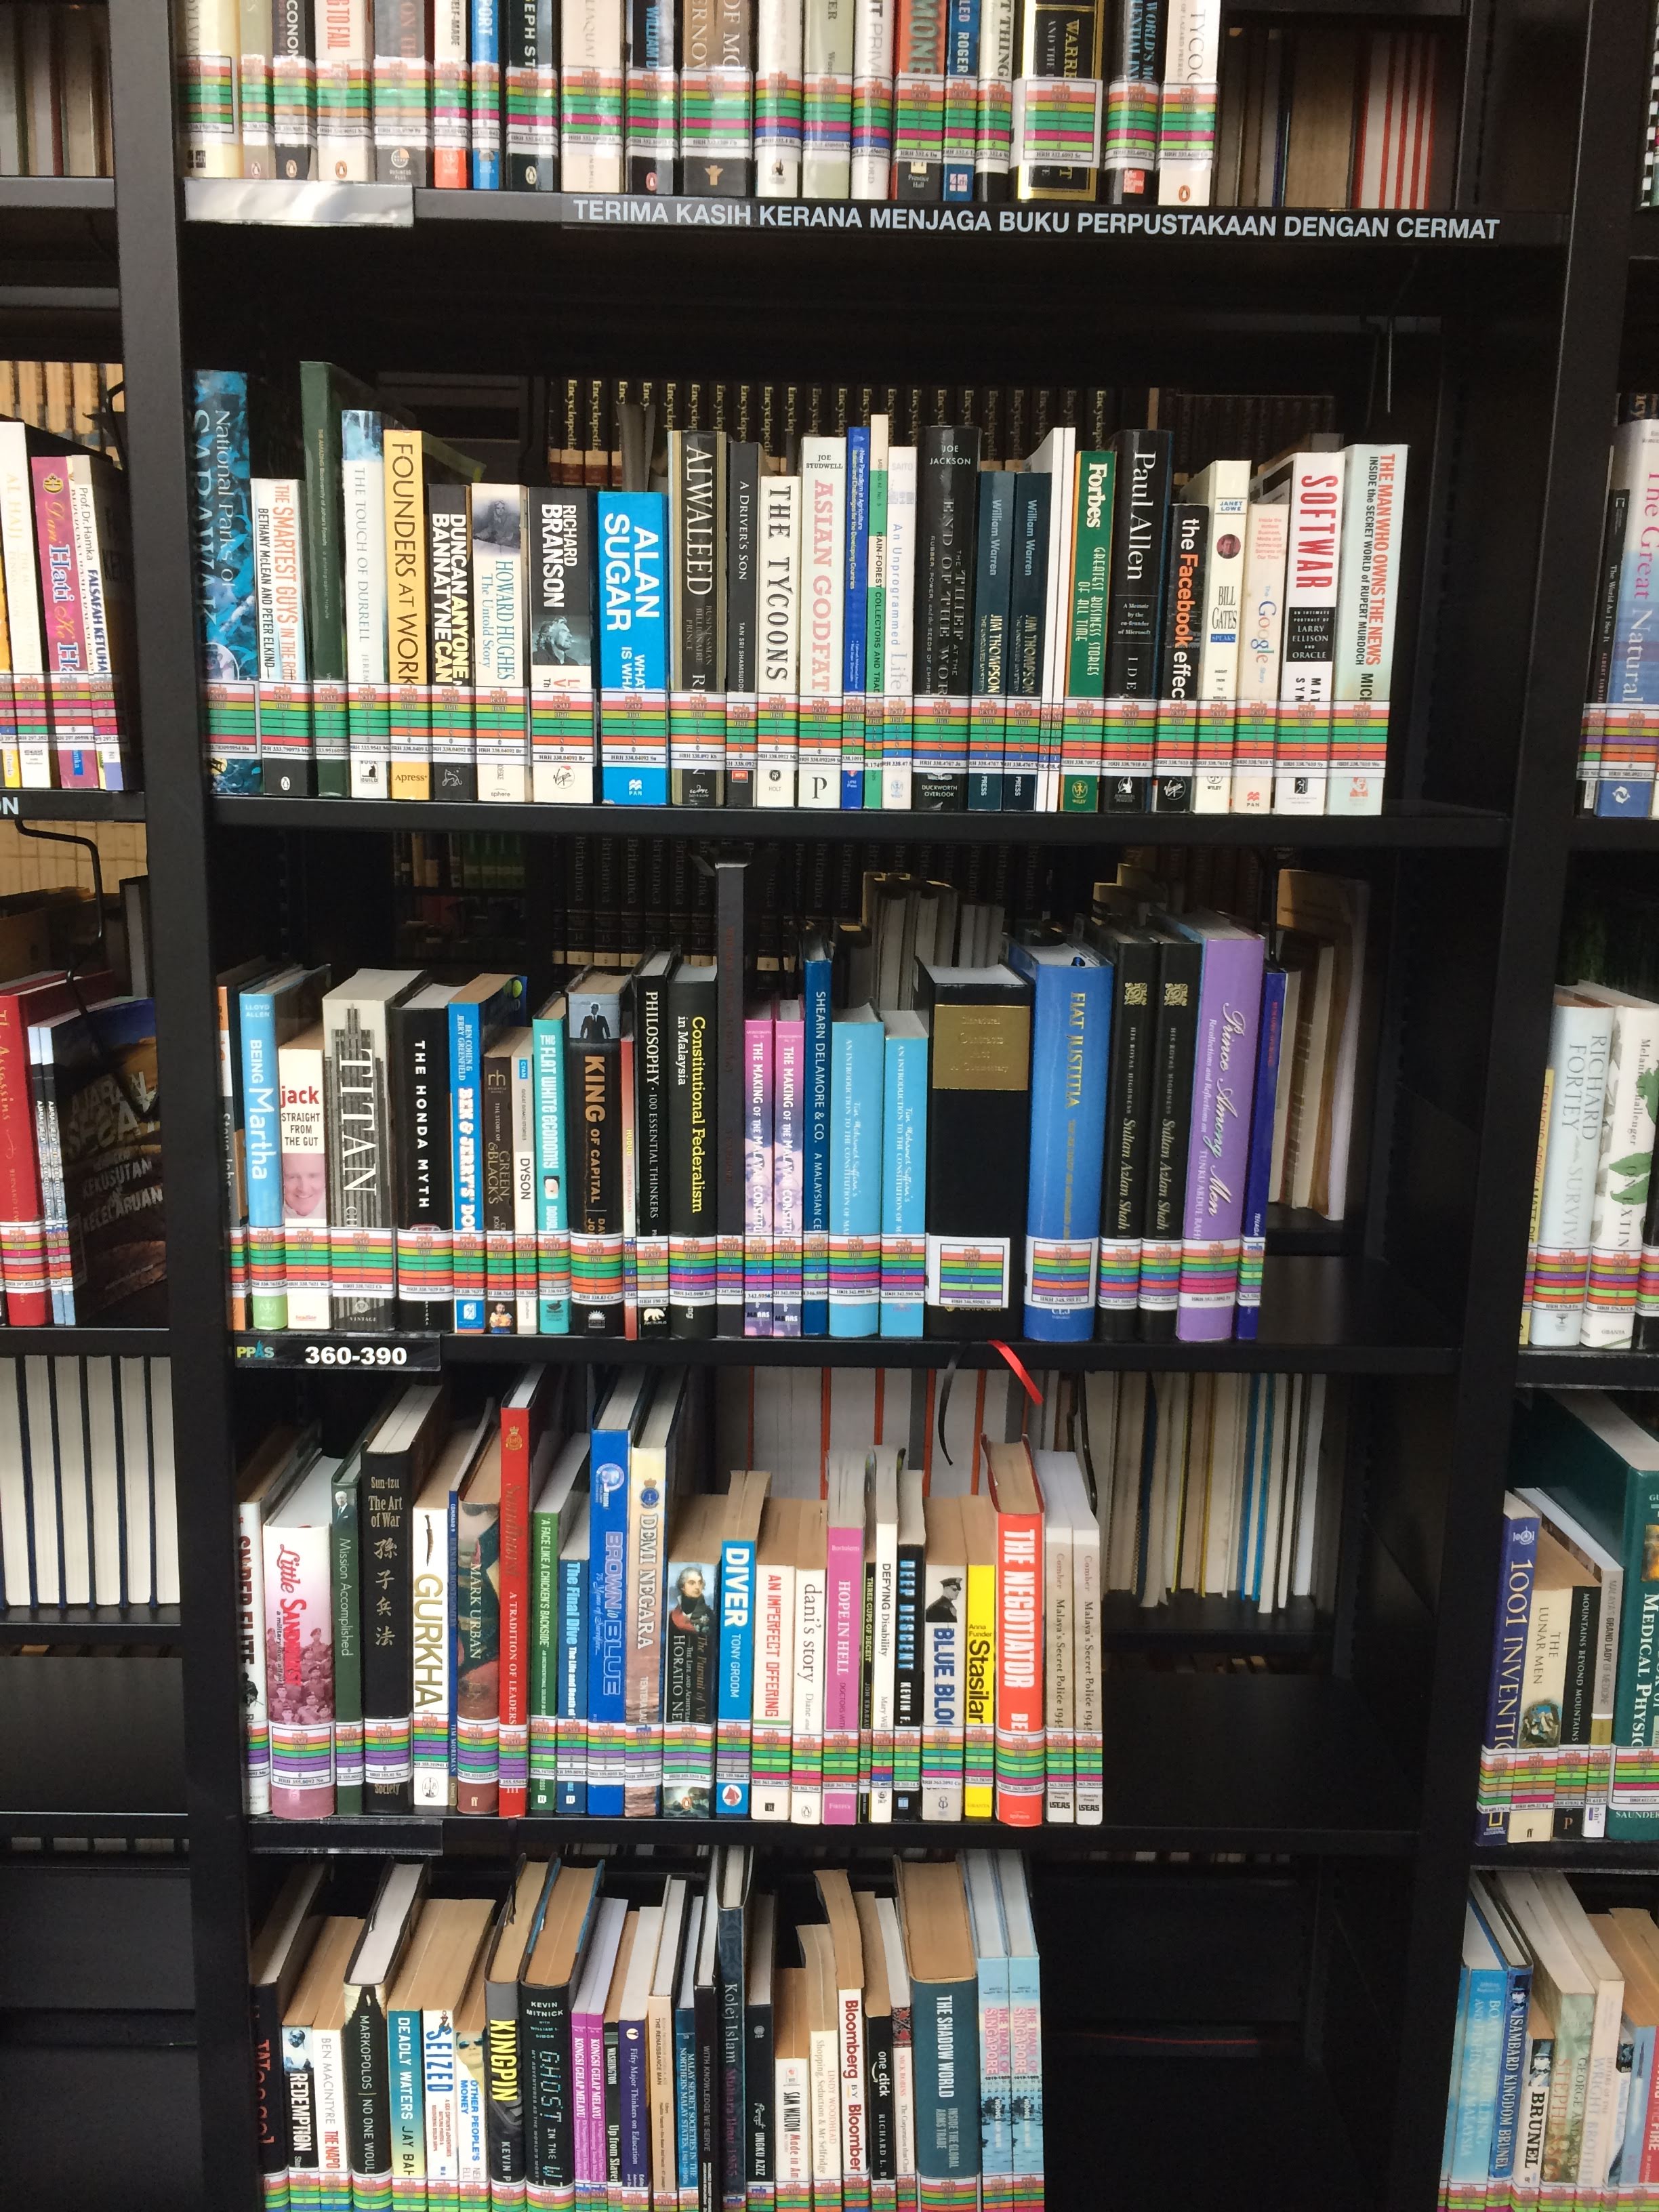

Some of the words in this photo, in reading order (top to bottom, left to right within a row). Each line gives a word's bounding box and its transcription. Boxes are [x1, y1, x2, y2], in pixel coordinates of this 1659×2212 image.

[958, 32, 969, 73] ROGER
[573, 200, 668, 224] TERIMA
[676, 203, 752, 226] KASIH
[759, 206, 862, 228] KERANA
[869, 207, 991, 231] MENJAGA
[999, 211, 1069, 233] BUKU
[1078, 213, 1275, 237] PERPUSTAKAAN
[1284, 215, 1389, 239] DENGAN
[1397, 218, 1499, 240] CERMAT
[740, 481, 749, 490] A
[1133, 451, 1156, 508] Paul
[1368, 456, 1378, 487] INSIDE
[80, 488, 88, 508] Prof.
[275, 485, 289, 504] THE
[768, 485, 791, 538] THE
[1086, 463, 1107, 528] Forbes
[82, 510, 90, 524] Dr.
[563, 505, 577, 567] RICHARD
[687, 445, 713, 595] ALWALEED
[740, 495, 750, 551] DRIVER'S
[893, 525, 903, 537] An
[991, 499, 1002, 537] William
[1027, 500, 1038, 536] William
[1366, 505, 1374, 538] SECRET
[83, 527, 93, 560] Hamka
[273, 507, 297, 582] SMARTEST
[542, 504, 564, 607] BRANSON
[989, 540, 1000, 575] Warren
[1025, 540, 1036, 575] Warren
[1126, 514, 1151, 580] Allen
[1362, 540, 1372, 573] WORLD
[49, 544, 69, 603] Hati
[605, 514, 632, 631] SUGAR
[634, 527, 659, 618] ALAN
[739, 554, 747, 580] SON
[276, 586, 298, 623] GUYS
[495, 560, 515, 628] HOWARD
[891, 547, 902, 645] Unprogrammed
[1218, 586, 1235, 605] BILL
[1360, 583, 1370, 618] RUPERT
[281, 628, 295, 637] IN
[766, 557, 791, 681] TYCOONS
[1212, 608, 1237, 630] GATES
[281, 640, 296, 657] THE
[497, 632, 515, 680] HUGHES
[1355, 621, 1368, 665] MURDOCH
[890, 653, 907, 690] Life
[678, 1017, 684, 1028] in
[816, 992, 825, 1041] SHEARN
[414, 1040, 426, 1075] THE
[647, 991, 659, 1086] PHILOSOPHY
[678, 1031, 686, 1085] Malaysia
[753, 1043, 762, 1061] THE
[249, 1040, 264, 1084] BEING
[693, 1017, 705, 1126] Constitutional
[815, 1044, 825, 1109] DELAMORE
[281, 1086, 319, 1108] jack
[585, 1056, 606, 1122] KING
[753, 1063, 763, 1104] MAKING
[1562, 1045, 1586, 1130] FORTEY
[1582, 1036, 1607, 1140] RICHARD
[282, 1113, 320, 1122] STRAIGHT
[291, 1125, 312, 1134] FROM
[339, 1048, 377, 1195] TITAN
[417, 1086, 428, 1149] HONDA
[754, 1106, 761, 1117] OF
[754, 1118, 762, 1133] THE
[815, 1112, 824, 1121] &
[249, 1088, 276, 1179] Martha
[285, 1137, 300, 1145] THE
[303, 1137, 318, 1146] GUT
[590, 1129, 600, 1145] OF
[649, 1112, 658, 1162] ESSENTIAL
[815, 1124, 824, 1143] CO.
[417, 1160, 430, 1208] MYTH
[520, 1158, 531, 1200] DYSON
[590, 1149, 600, 1203] CAPITAL
[693, 1128, 705, 1213] Federalism
[649, 1164, 659, 1218] THINKERS
[305, 1347, 407, 1365] 360-390
[371, 1477, 399, 1488] Sun-tzu
[369, 1496, 384, 1510] The
[388, 1496, 403, 1511] Art
[371, 1513, 381, 1528] of
[383, 1513, 400, 1528] War
[1004, 1529, 1035, 1563] THE
[373, 1538, 398, 1647] 孫子兵法
[724, 1548, 750, 1626] DIVER
[882, 1563, 891, 1610] DEFYING
[899, 1560, 915, 1596] DEEP
[1506, 1560, 1535, 1626] 1001
[881, 1612, 890, 1657] Disability
[899, 1604, 915, 1669] DESCENT
[1004, 1571, 1035, 1687] NEGOTIATOR
[1057, 1599, 1065, 1639] Malaya's
[1535, 1607, 1549, 1649] LUNAR
[1579, 1594, 1589, 1645] MOUNTAINS
[1637, 1594, 1658, 1675] MEDICAL
[413, 1574, 444, 1708] GURKHA
[731, 1634, 741, 1658] TONY
[933, 1629, 955, 1677] BLUE
[1057, 1642, 1065, 1677] Secret
[731, 1661, 740, 1698] GROOM
[1534, 1652, 1542, 1684] MEN
[1575, 1648, 1585, 1688] BEYOND
[901, 1682, 911, 1711] KEVIN
[1057, 1678, 1065, 1704] Police
[1572, 1691, 1582, 1742] MOUNTAINS
[724, 1984, 737, 2021] Kolej
[321, 2039, 331, 2059] BEN
[360, 2015, 372, 2089] MARKOPOLOS
[426, 2027, 453, 2092] SEIZED
[490, 2020, 518, 2101] KINGPIN
[725, 2026, 735, 2063] Islam
[843, 2000, 859, 2079] Bloomberg
[851, 2085, 858, 2098] BY
[540, 2051, 561, 2122] GHOST
[607, 2048, 617, 2085] WASHINGTON
[878, 2072, 888, 2097] click
[289, 2073, 312, 2151] REDEMPTION
[323, 2062, 335, 2125] MACINTYRE
[363, 2100, 373, 2114] NO
[460, 2080, 468, 2114] MONEY
[470, 2081, 479, 2113] OTHER
[364, 2116, 373, 2139] ONE
[472, 2115, 480, 2161] PEOPLE'S
[548, 2128, 556, 2139] IN
[755, 2132, 765, 2156] UNGKU
[1525, 2092, 1544, 2169] BRUNEL
[548, 2142, 556, 2159] THE
[756, 2159, 766, 2176] AZIZ
